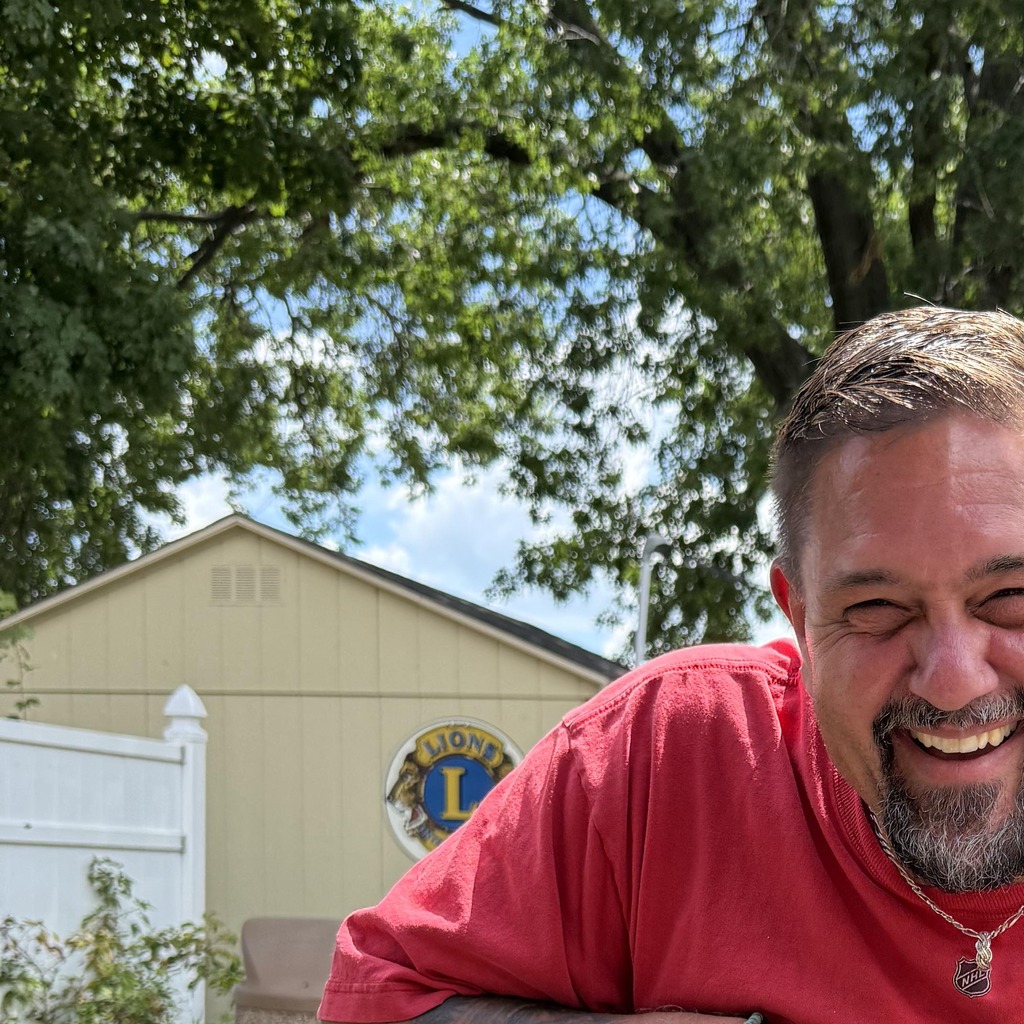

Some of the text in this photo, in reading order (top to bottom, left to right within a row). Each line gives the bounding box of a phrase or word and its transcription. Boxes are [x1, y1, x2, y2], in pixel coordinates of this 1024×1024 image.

[422, 730, 498, 762] LIONS
[440, 766, 478, 821] L
[961, 970, 986, 988] NHL
